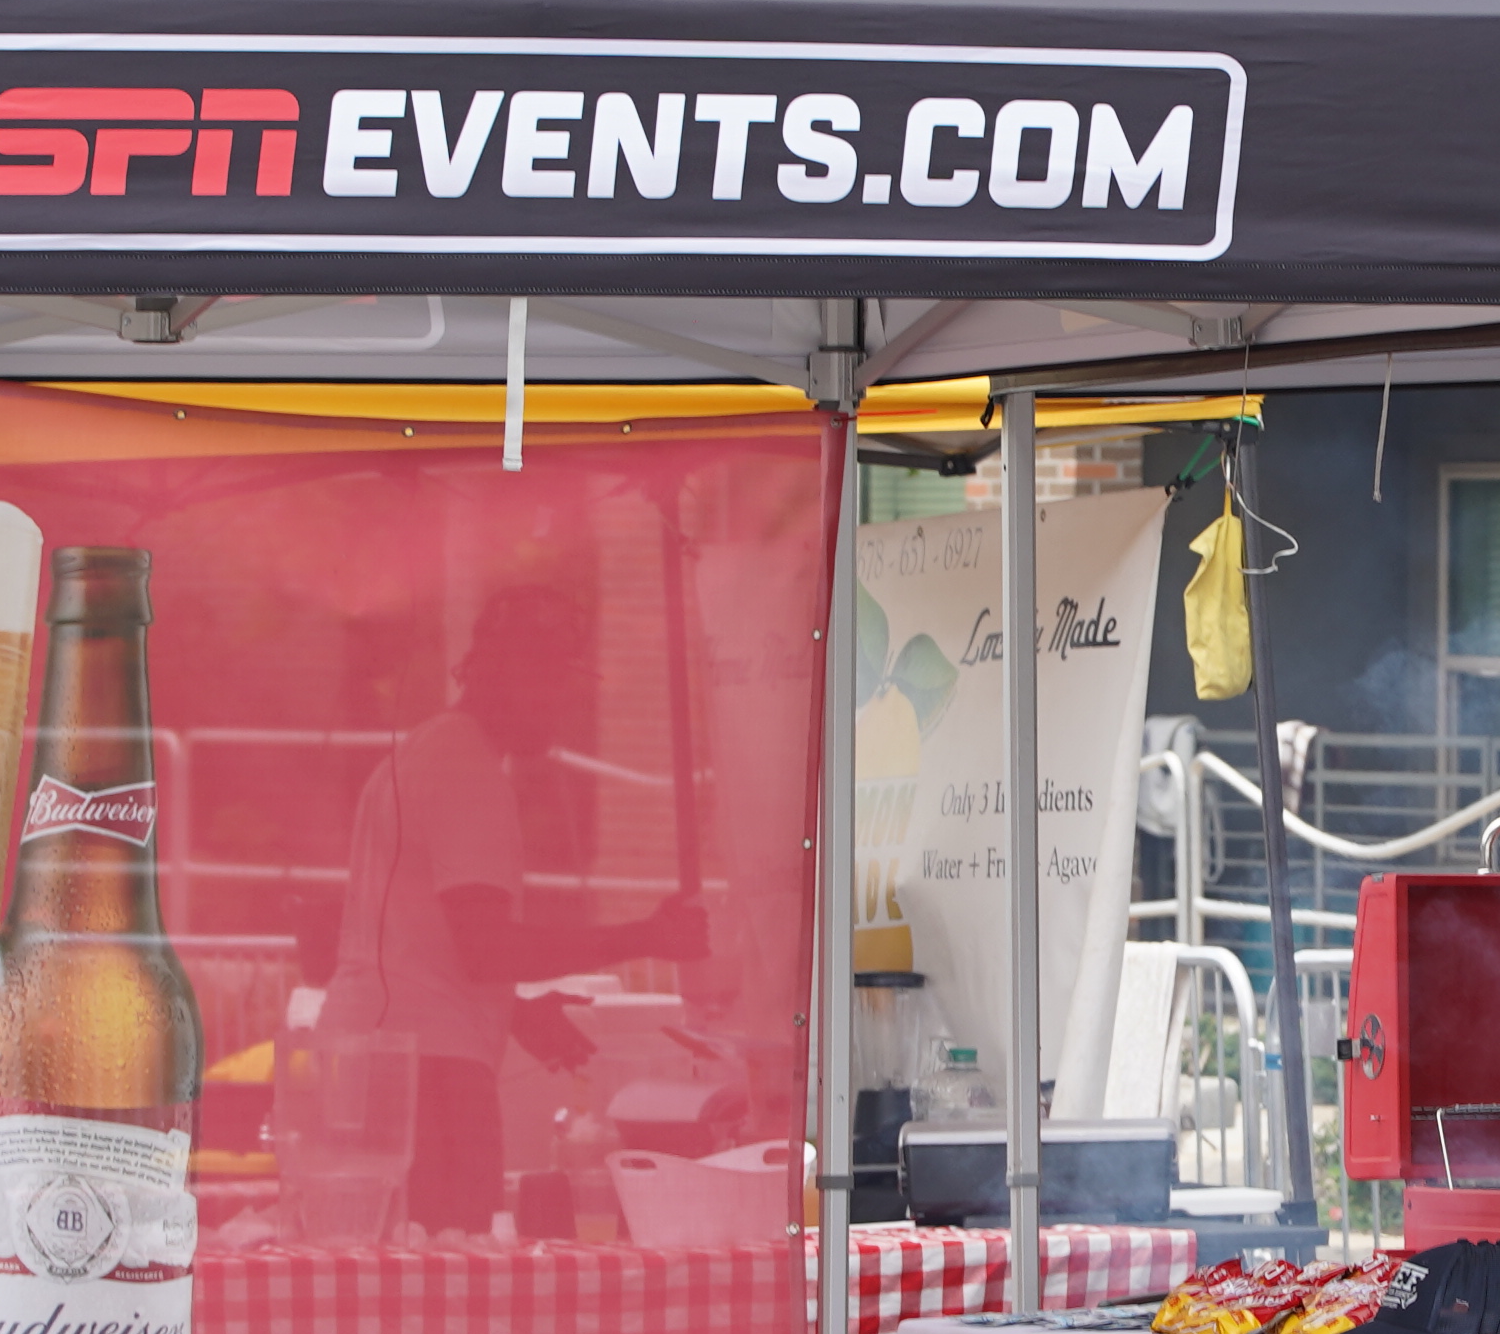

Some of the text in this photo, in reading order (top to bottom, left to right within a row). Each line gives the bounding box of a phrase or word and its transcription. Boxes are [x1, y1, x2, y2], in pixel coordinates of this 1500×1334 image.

[322, 89, 1194, 210] EVENTS.COM
[1048, 596, 1122, 661] Made
[30, 787, 156, 826] Budweiser
